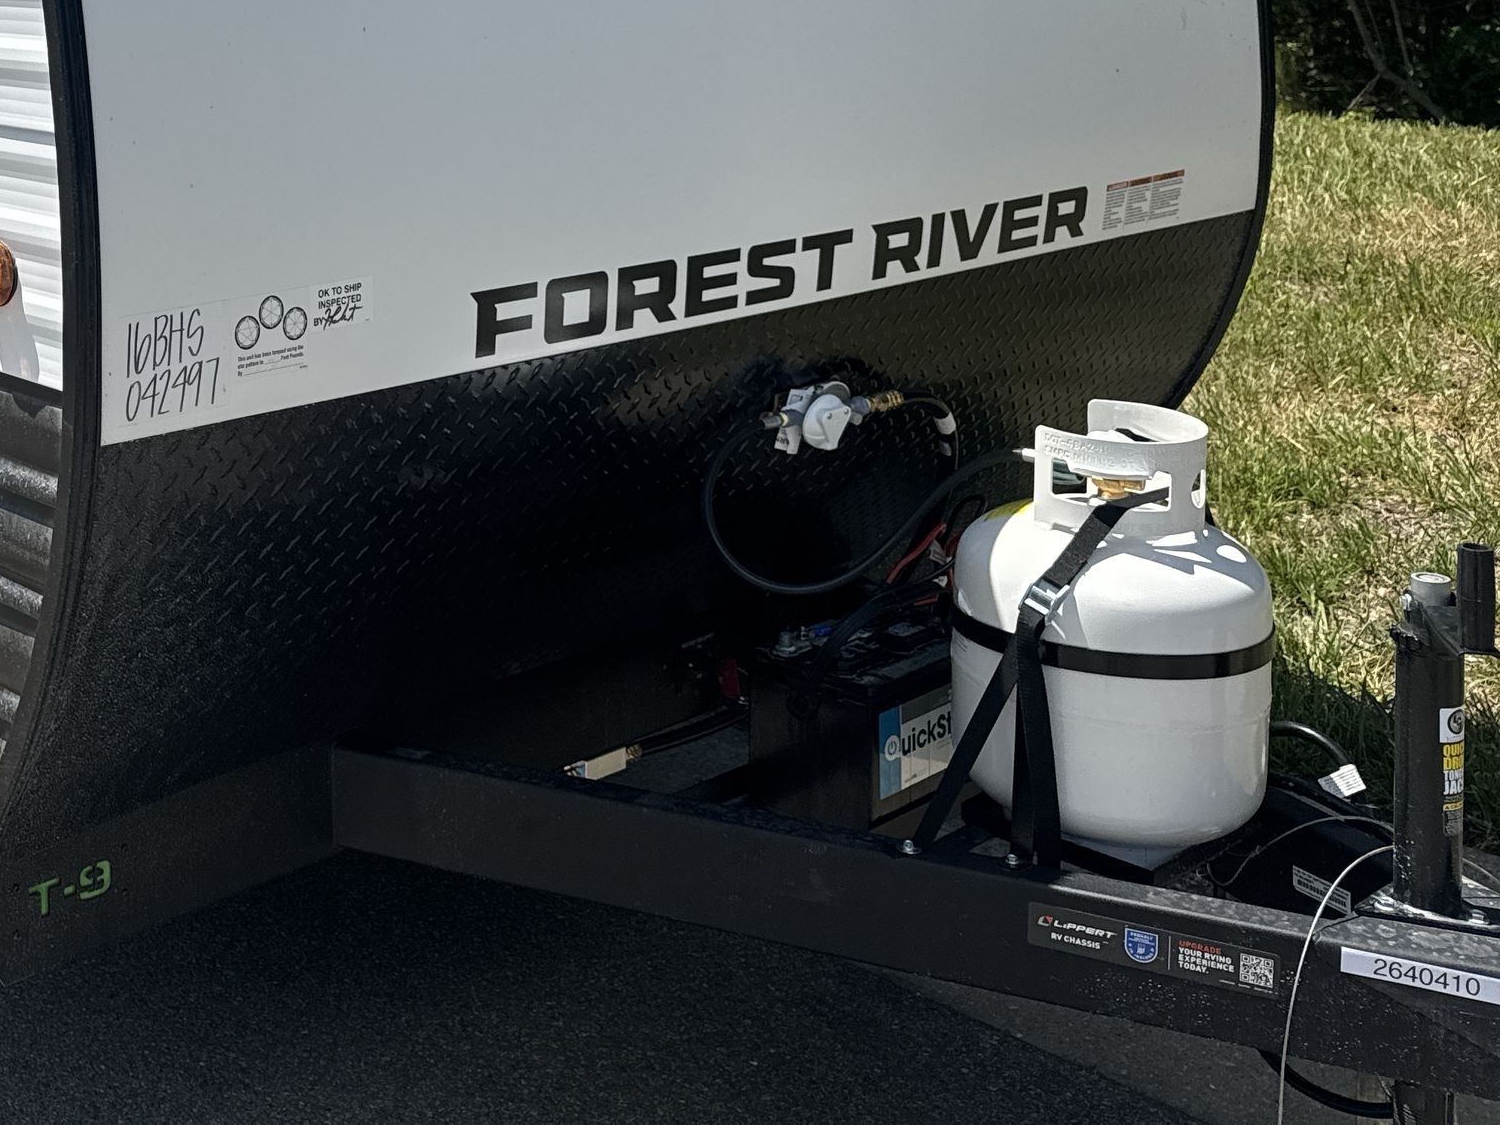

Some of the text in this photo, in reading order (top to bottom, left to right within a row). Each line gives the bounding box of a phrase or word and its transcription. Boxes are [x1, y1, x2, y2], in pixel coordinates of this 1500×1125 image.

[470, 228, 854, 359] FOREST
[871, 186, 1088, 280] RIVER
[318, 282, 362, 298] OK TO SHIP
[318, 293, 362, 310] INSPECTED
[126, 308, 204, 378] 16BHS
[126, 357, 220, 422] 042497
[28, 859, 111, 915] T-9
[1053, 920, 1115, 939] LIPPERT
[1051, 932, 1100, 950] RV CHASSIS
[1178, 939, 1221, 955] UPGRADE
[1178, 954, 1235, 973] EXPERIENCE
[1179, 947, 1232, 965] YOUR RVING
[1178, 961, 1209, 975] TODAY.
[1373, 958, 1481, 996] 2640410
